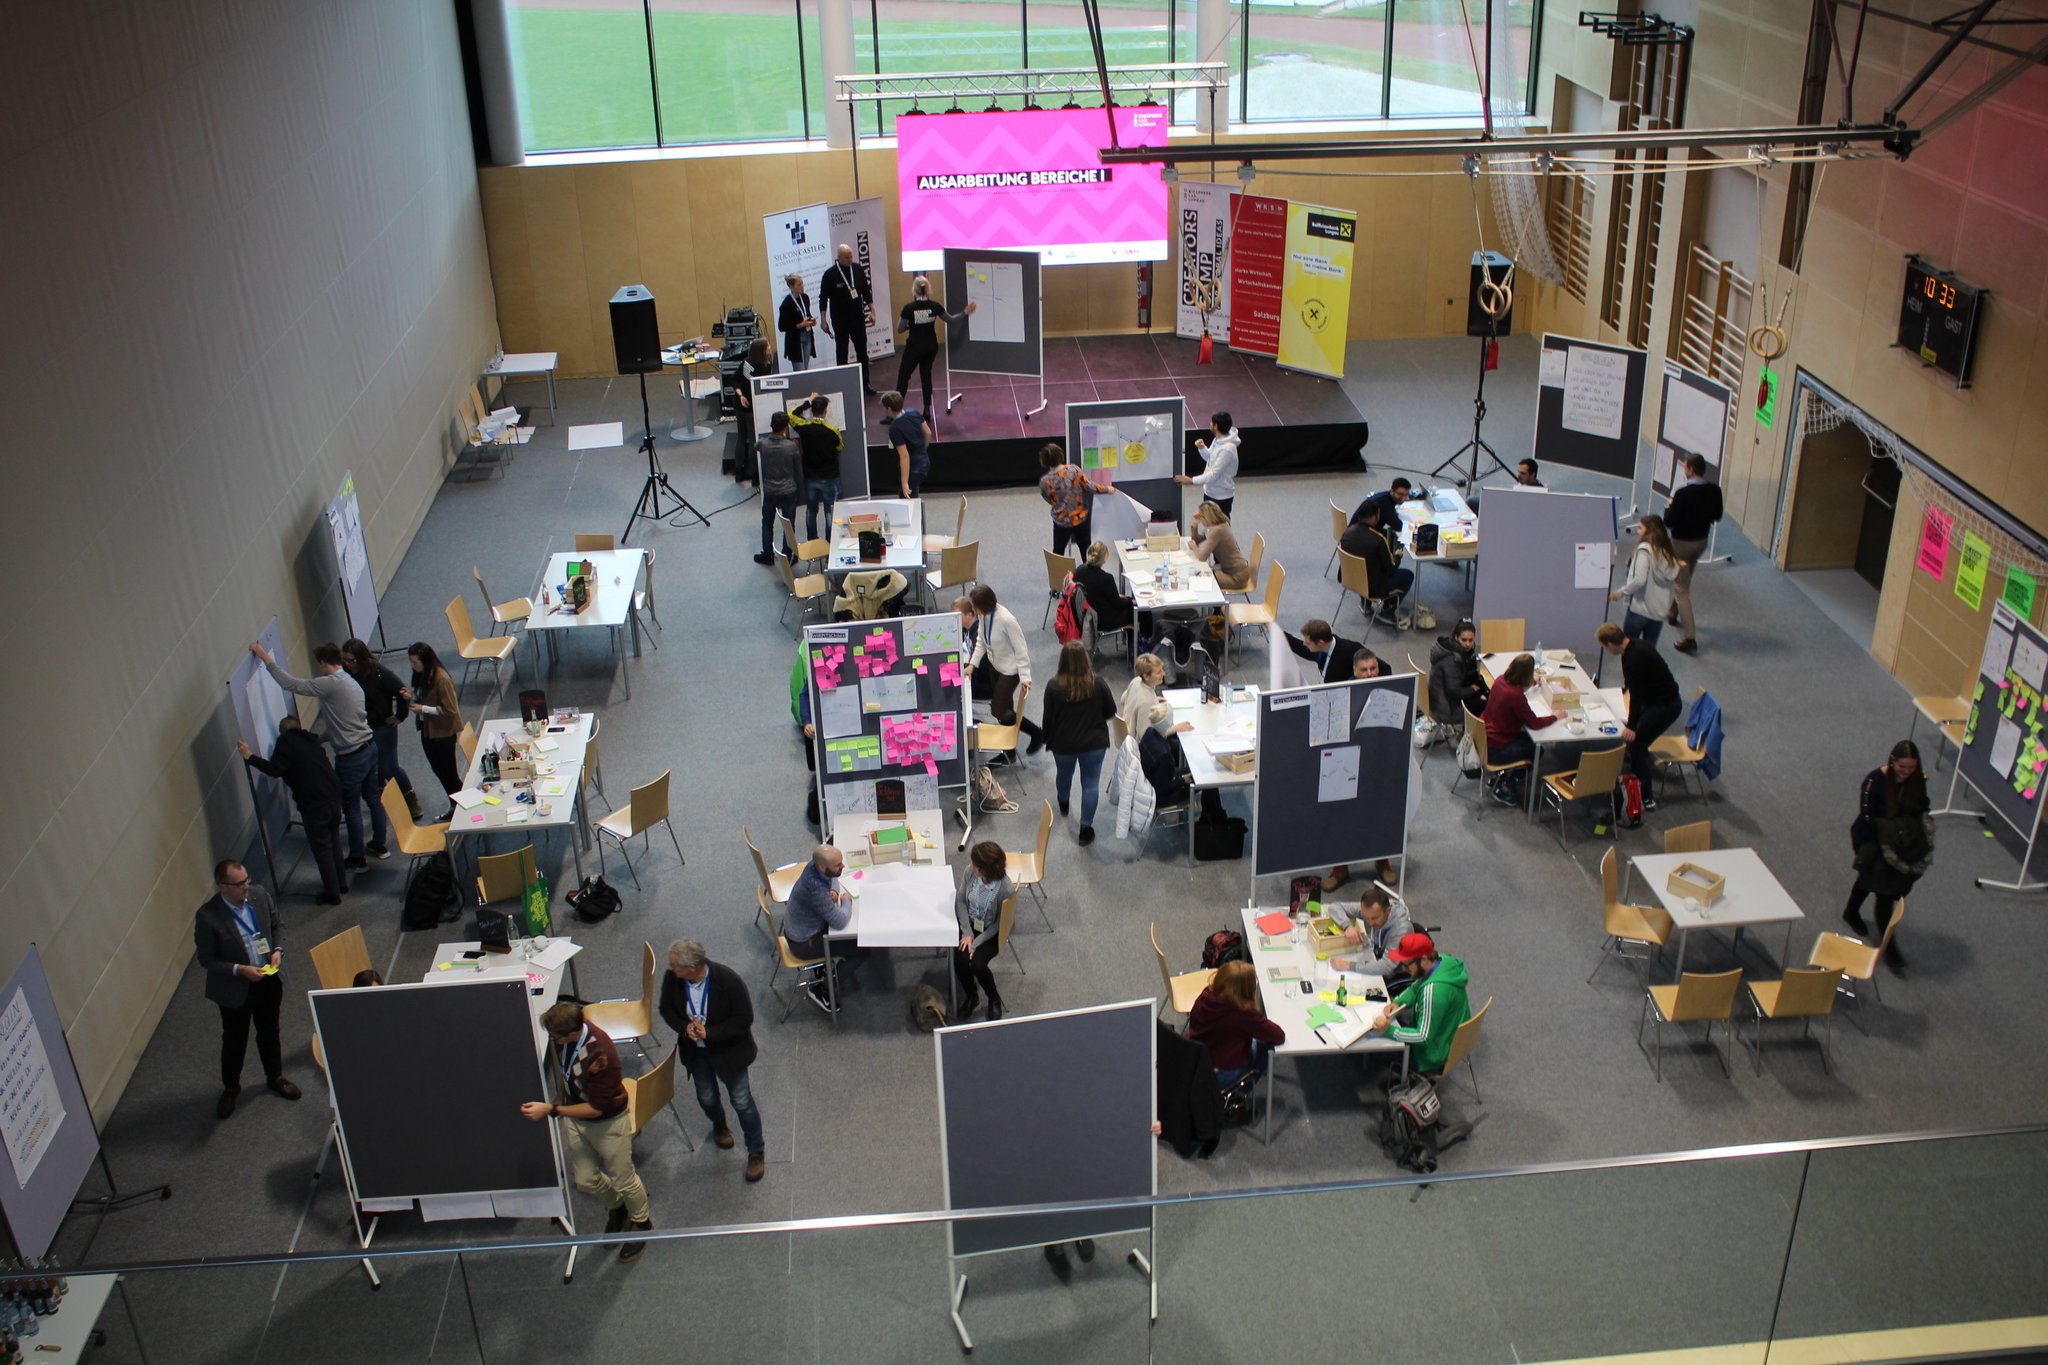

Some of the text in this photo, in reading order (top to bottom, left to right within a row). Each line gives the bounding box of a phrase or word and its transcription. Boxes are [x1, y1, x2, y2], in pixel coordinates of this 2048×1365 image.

[919, 173, 1028, 190] AUSARBEITUNG
[1030, 169, 1098, 185] BEREICHE
[1215, 219, 1223, 248] IDEAS
[1237, 278, 1283, 290] Wirtschaftskammer
[1906, 295, 1923, 313] HEIM
[1938, 283, 1956, 309] 33
[1253, 310, 1280, 323] Salzburg
[1944, 315, 1963, 335] GAST
